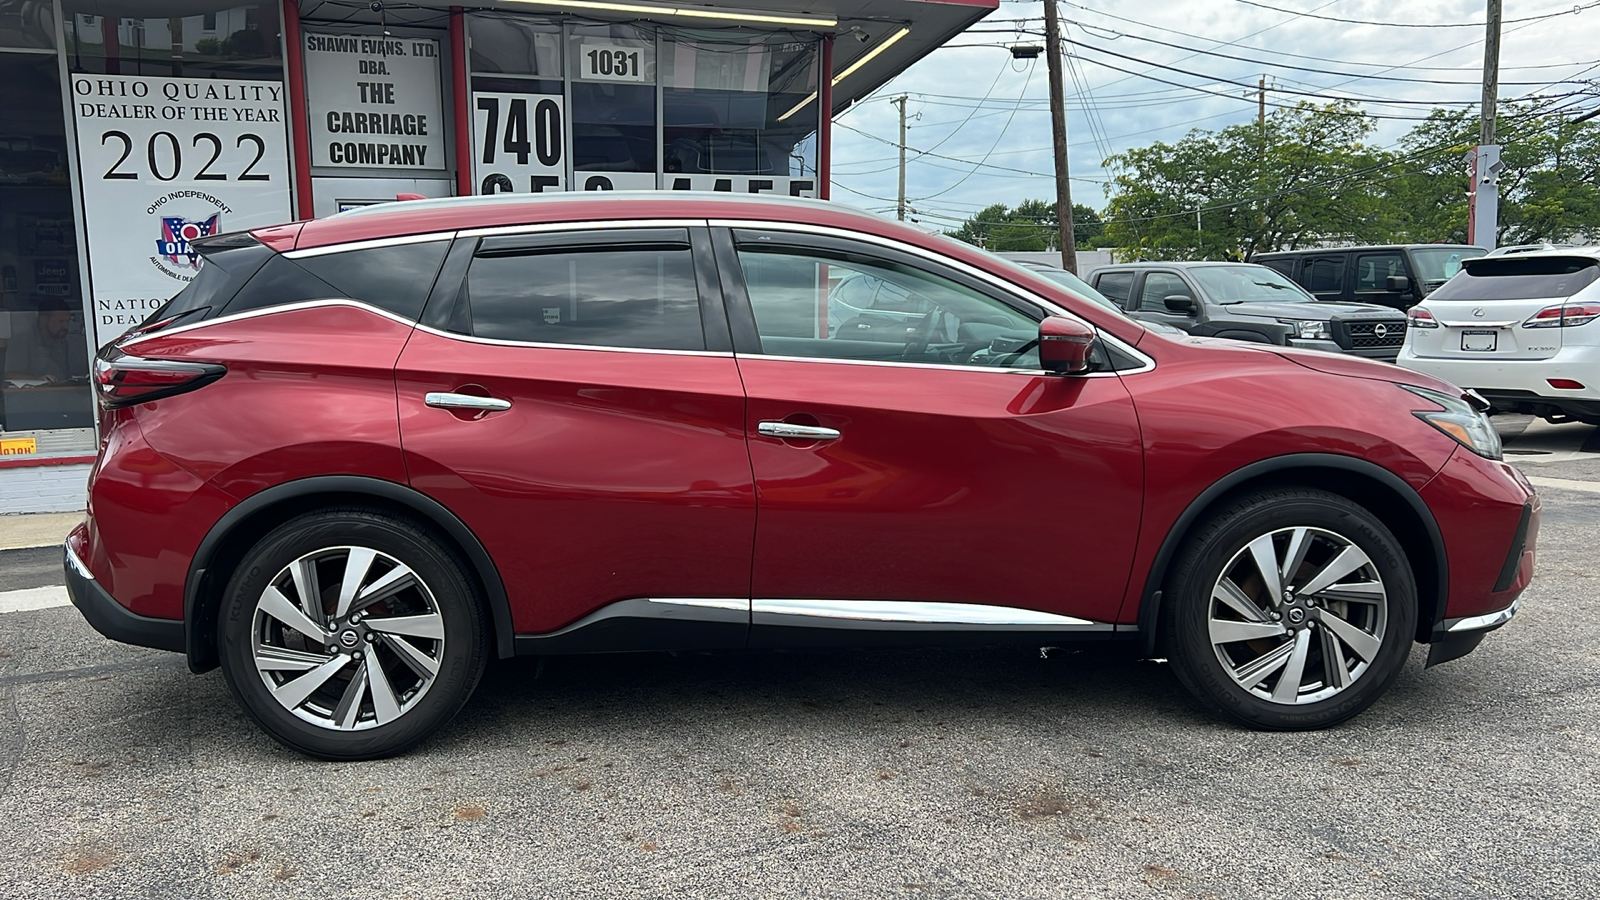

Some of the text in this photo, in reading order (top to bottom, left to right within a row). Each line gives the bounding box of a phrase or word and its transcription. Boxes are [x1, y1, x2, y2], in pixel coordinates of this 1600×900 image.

[307, 36, 358, 53] SHAWN
[412, 42, 437, 58] LTD.
[358, 60, 390, 75] DBA.
[587, 49, 638, 76] 1031
[75, 79, 281, 102] OHIO QUALITY
[357, 82, 395, 104] THE
[80, 103, 280, 123] DEALER OF THE YEAR
[326, 111, 428, 136] CARRIAGE
[477, 97, 562, 167] 740
[101, 130, 270, 182] 2022
[329, 142, 428, 165] COMPANY
[147, 190, 232, 215] OHIO INDEPENDENT
[39, 266, 66, 276] Jeep
[149, 256, 181, 280] AUTOMOBILE
[1357, 524, 1399, 570] KUMHO
[230, 565, 262, 622] KUMHO
